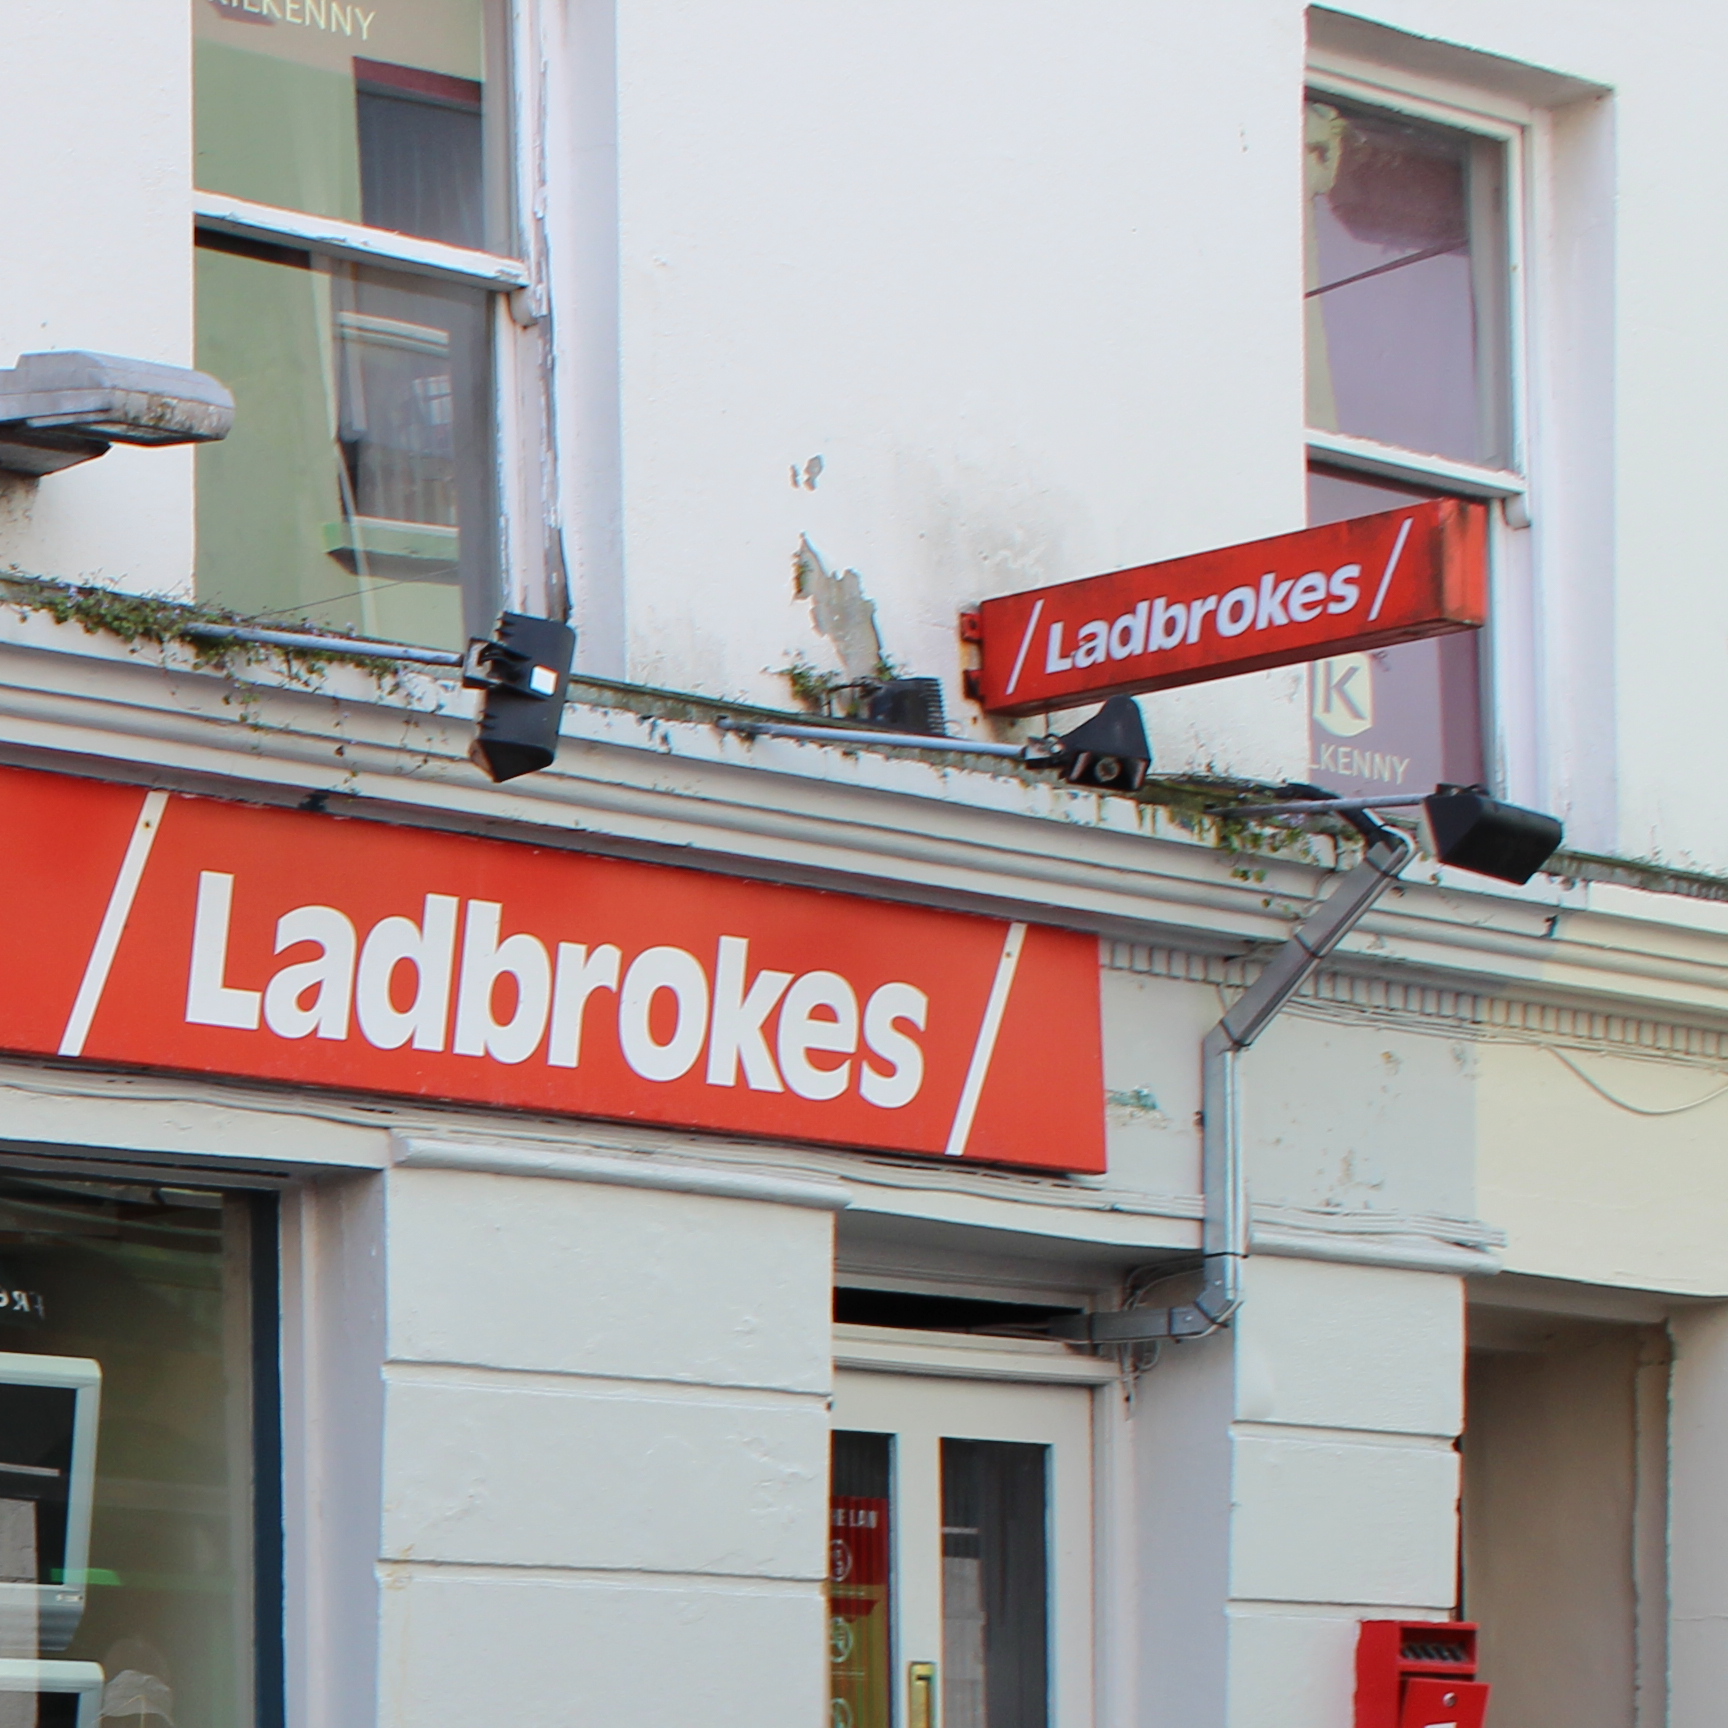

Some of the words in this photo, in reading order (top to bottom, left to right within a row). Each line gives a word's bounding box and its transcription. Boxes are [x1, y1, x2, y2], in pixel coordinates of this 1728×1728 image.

[1044, 562, 1362, 674] Ladbrokes
[1308, 742, 1411, 785] KENNY
[185, 869, 929, 1109] Ladbrokes
